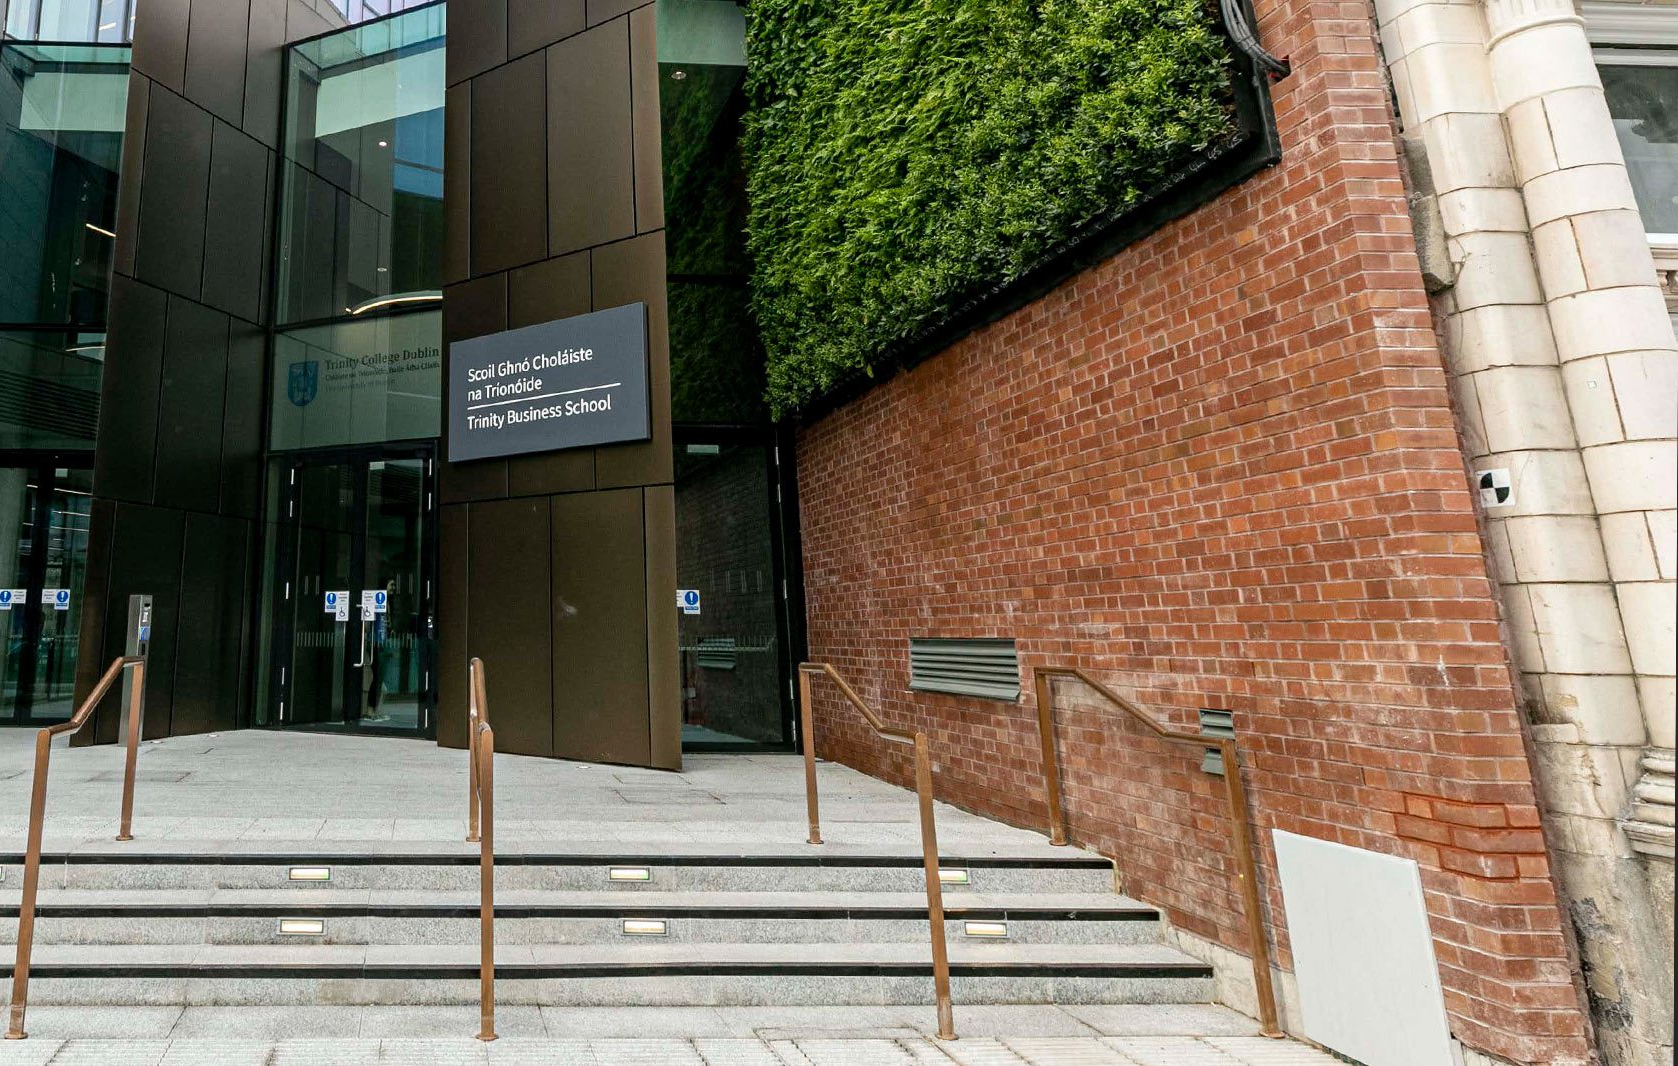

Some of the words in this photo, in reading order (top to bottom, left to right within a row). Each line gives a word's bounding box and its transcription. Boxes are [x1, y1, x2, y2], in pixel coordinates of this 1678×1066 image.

[325, 357, 359, 370] Trinity
[361, 352, 400, 366] College
[403, 347, 439, 361] Dublin
[468, 364, 495, 383] Scoil
[498, 357, 530, 377] Ghnó
[532, 347, 593, 370] Choláiste
[467, 387, 481, 402] na
[484, 376, 542, 399] Tríonóide
[467, 411, 504, 430] Trinity
[507, 406, 562, 424] Business
[565, 394, 611, 416] School
